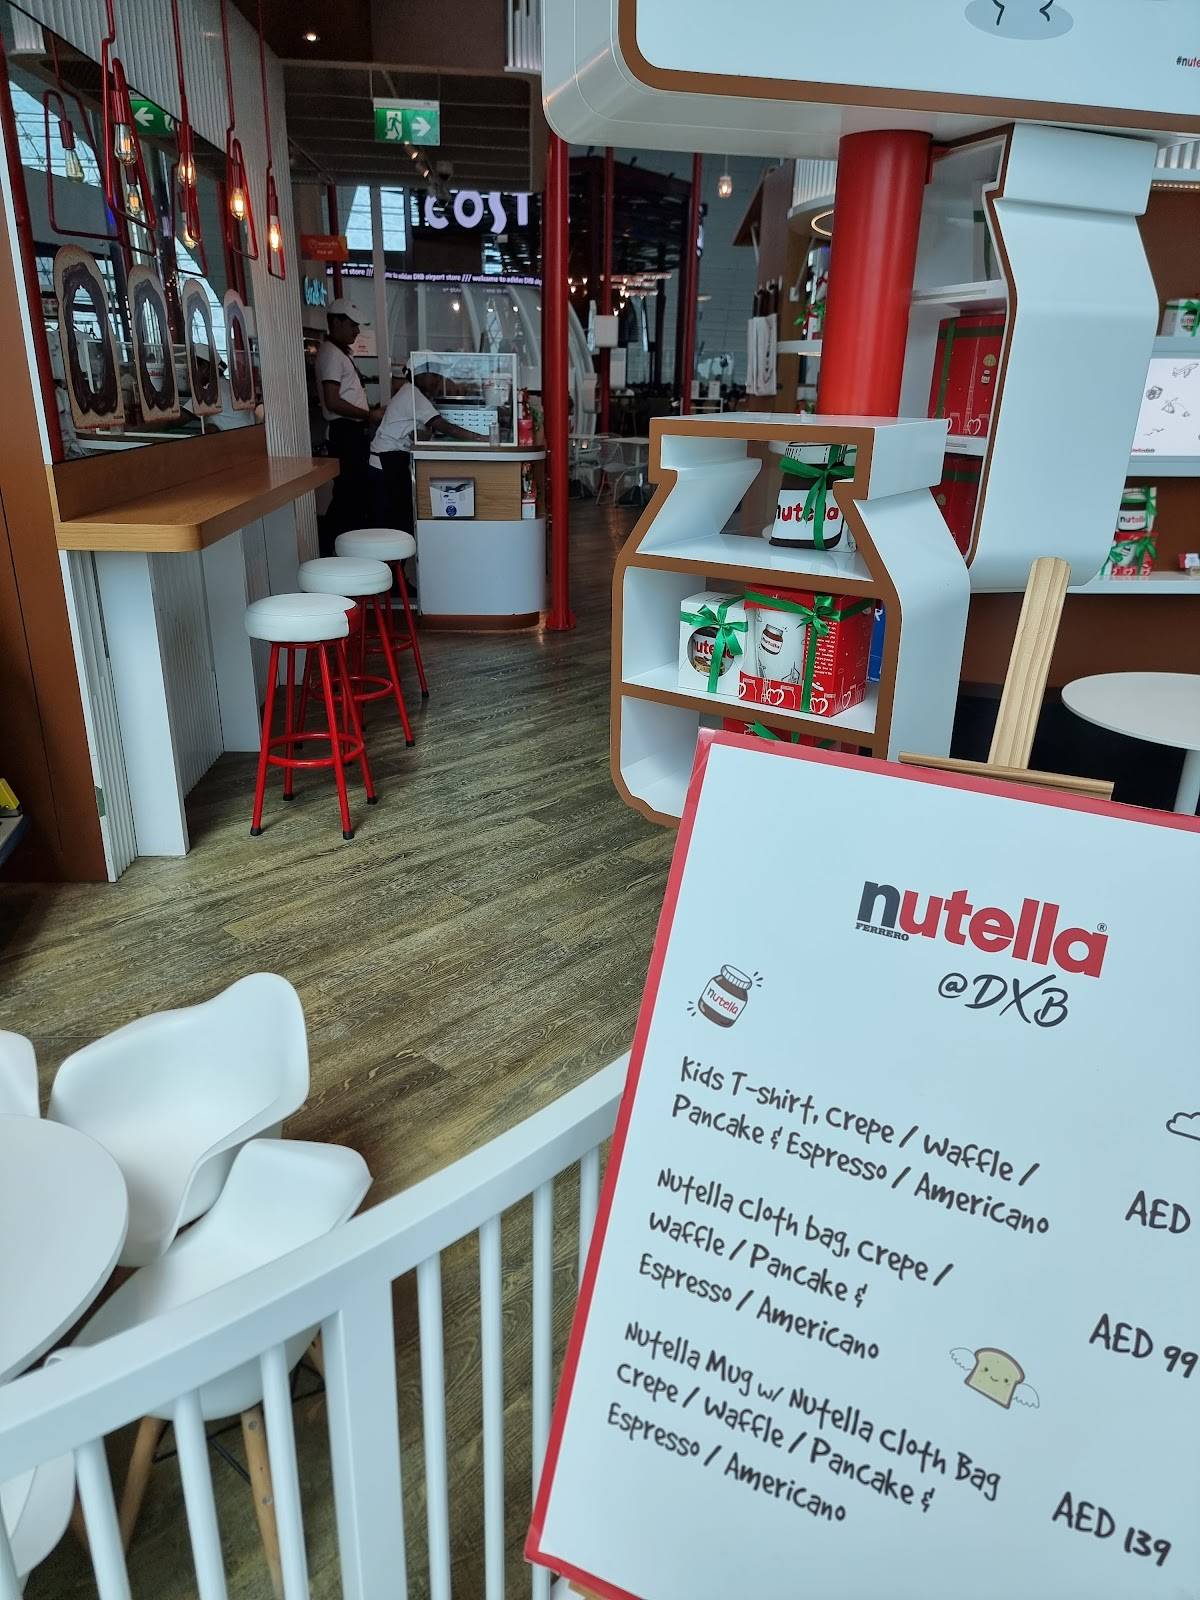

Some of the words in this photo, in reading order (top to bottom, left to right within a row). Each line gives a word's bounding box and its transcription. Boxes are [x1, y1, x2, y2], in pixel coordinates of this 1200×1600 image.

[855, 921, 910, 942] FERRERO
[707, 987, 739, 1015] nutella
[938, 973, 1069, 1028] @DXB
[681, 1056, 724, 1090] Kids
[732, 1072, 819, 1125] T-shirt,
[657, 1168, 733, 1214] Nutella
[672, 1094, 765, 1145] Pancake
[786, 1132, 888, 1180] Espresso
[914, 1172, 1050, 1234] Americano
[1125, 1190, 1191, 1234] AED
[639, 1253, 732, 1304] Espresso
[756, 1296, 880, 1360] Americano
[750, 1244, 849, 1302] Pancake
[1089, 1313, 1154, 1359] AED
[1164, 1346, 1199, 1379] 99
[625, 1322, 701, 1371] Nutella
[705, 1350, 754, 1397] Mug
[757, 1382, 785, 1403] w/
[789, 1388, 874, 1444] Nutella
[955, 1452, 1002, 1502] Bag
[608, 1402, 701, 1457] Espresso
[724, 1452, 847, 1522] Americano
[810, 1437, 915, 1506] Pancake
[1052, 1491, 1116, 1539] AED
[1124, 1527, 1172, 1568] 139
